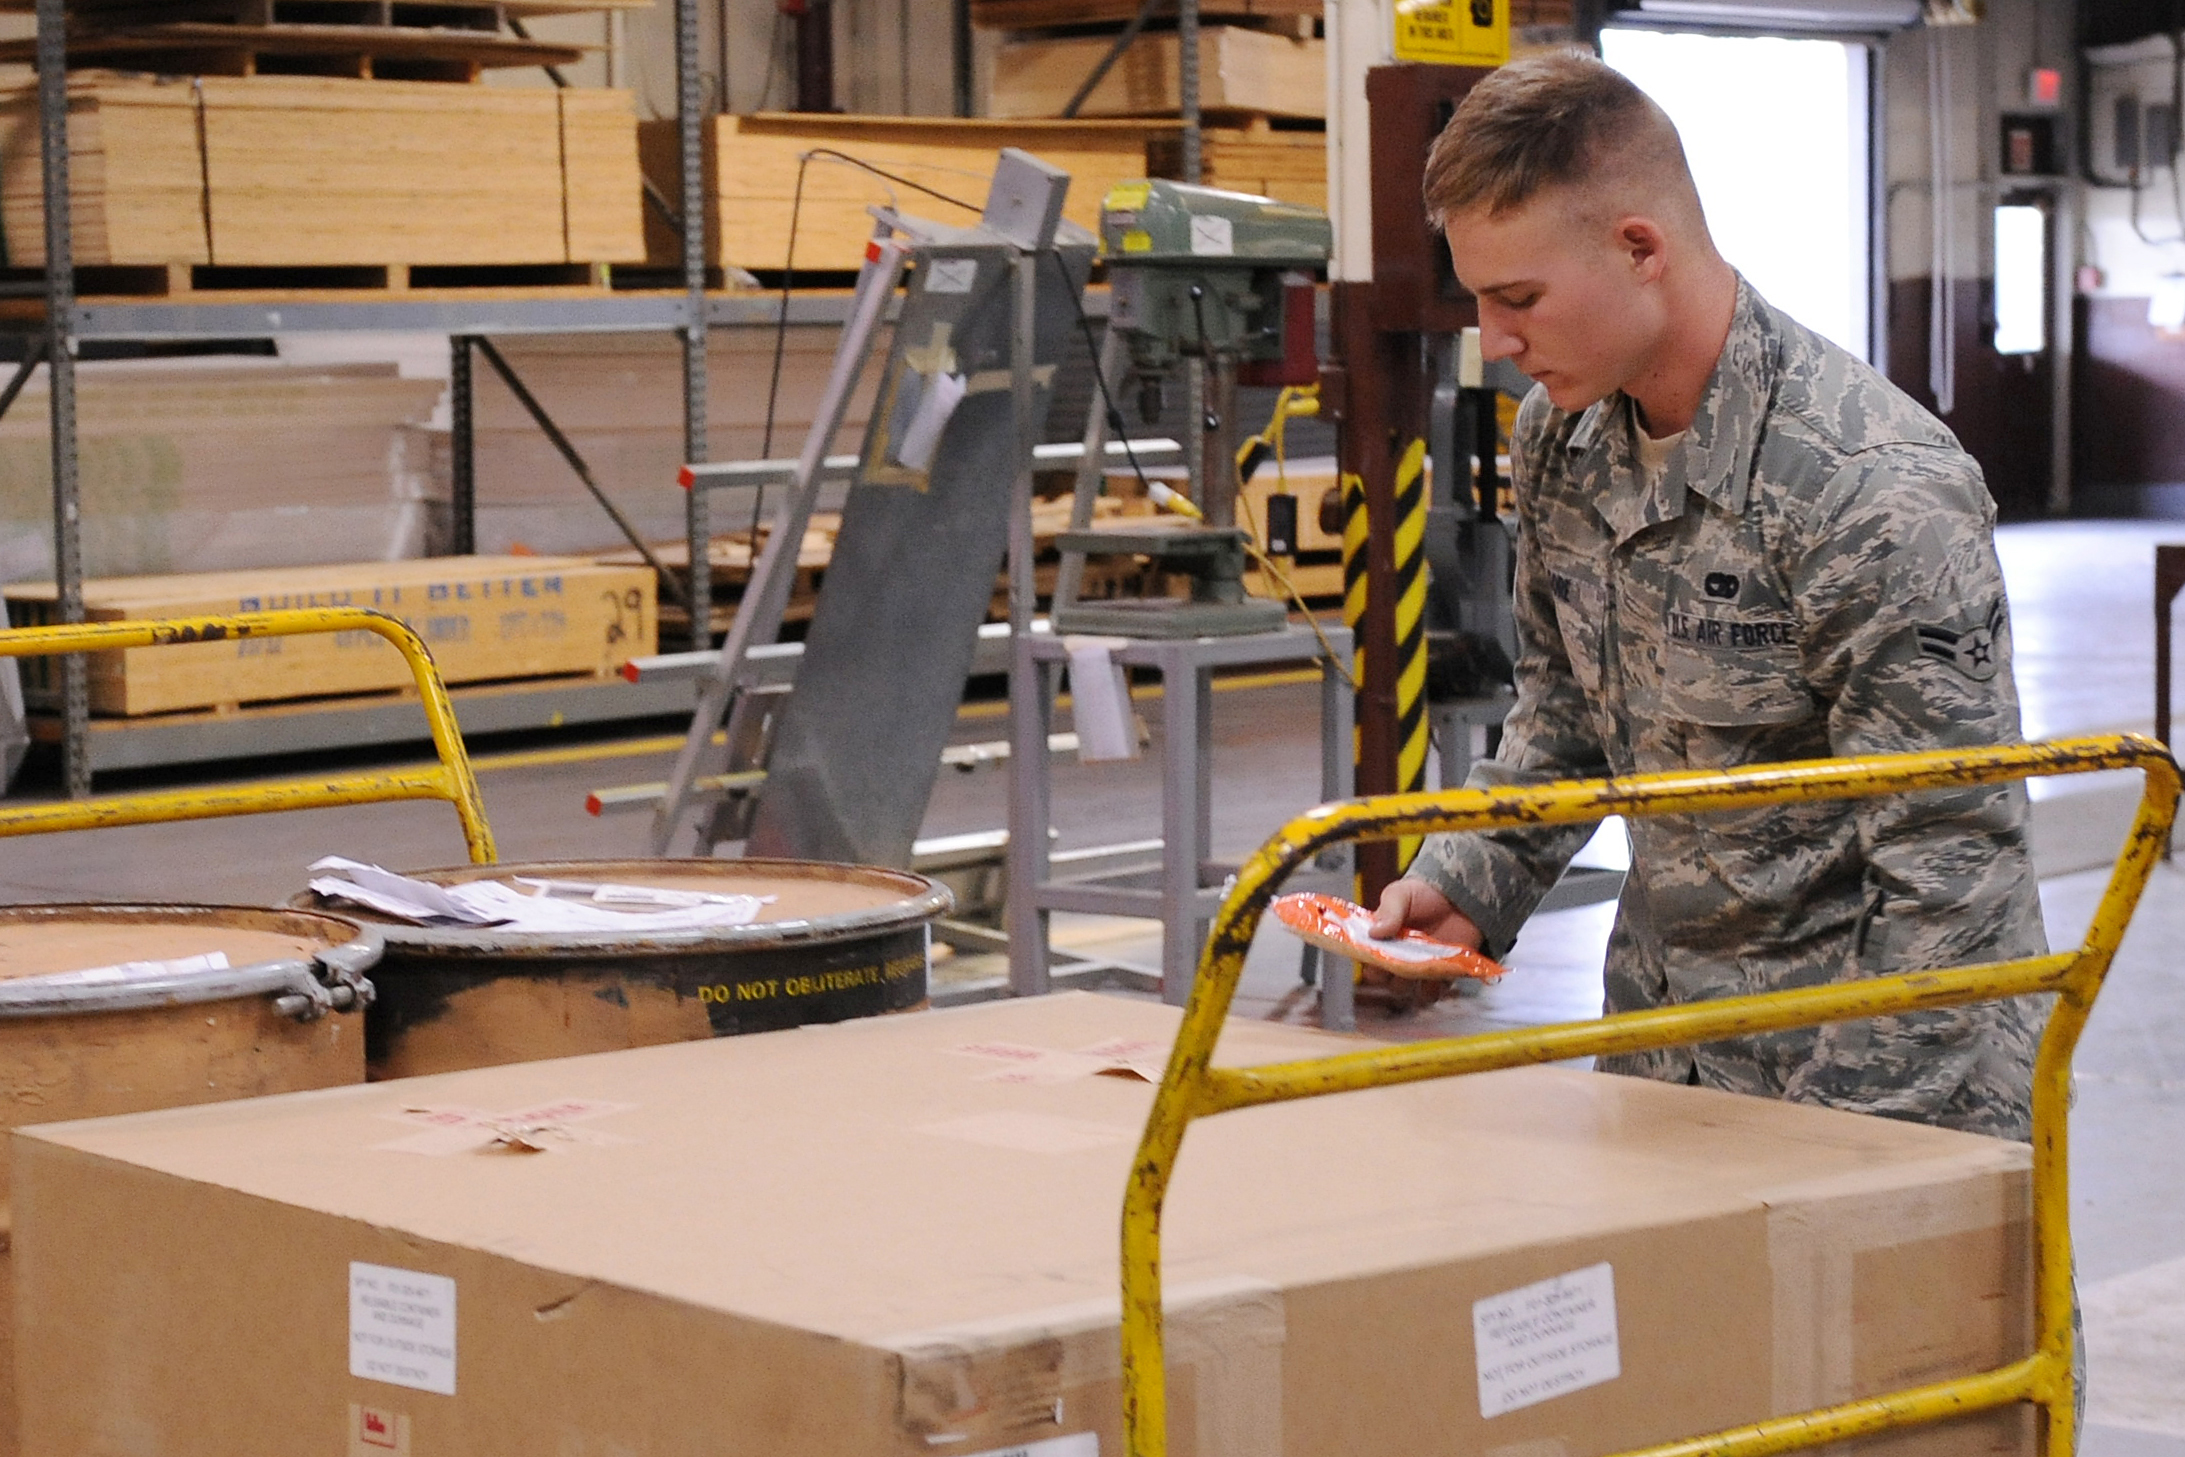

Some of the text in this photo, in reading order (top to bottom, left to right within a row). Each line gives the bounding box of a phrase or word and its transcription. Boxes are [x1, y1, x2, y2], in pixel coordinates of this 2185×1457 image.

[1696, 618, 1722, 646] AIR
[1730, 622, 1797, 647] FORCE
[698, 984, 731, 1003] DO
[736, 979, 779, 1001] NOT
[785, 966, 880, 997] OBLITERATE
